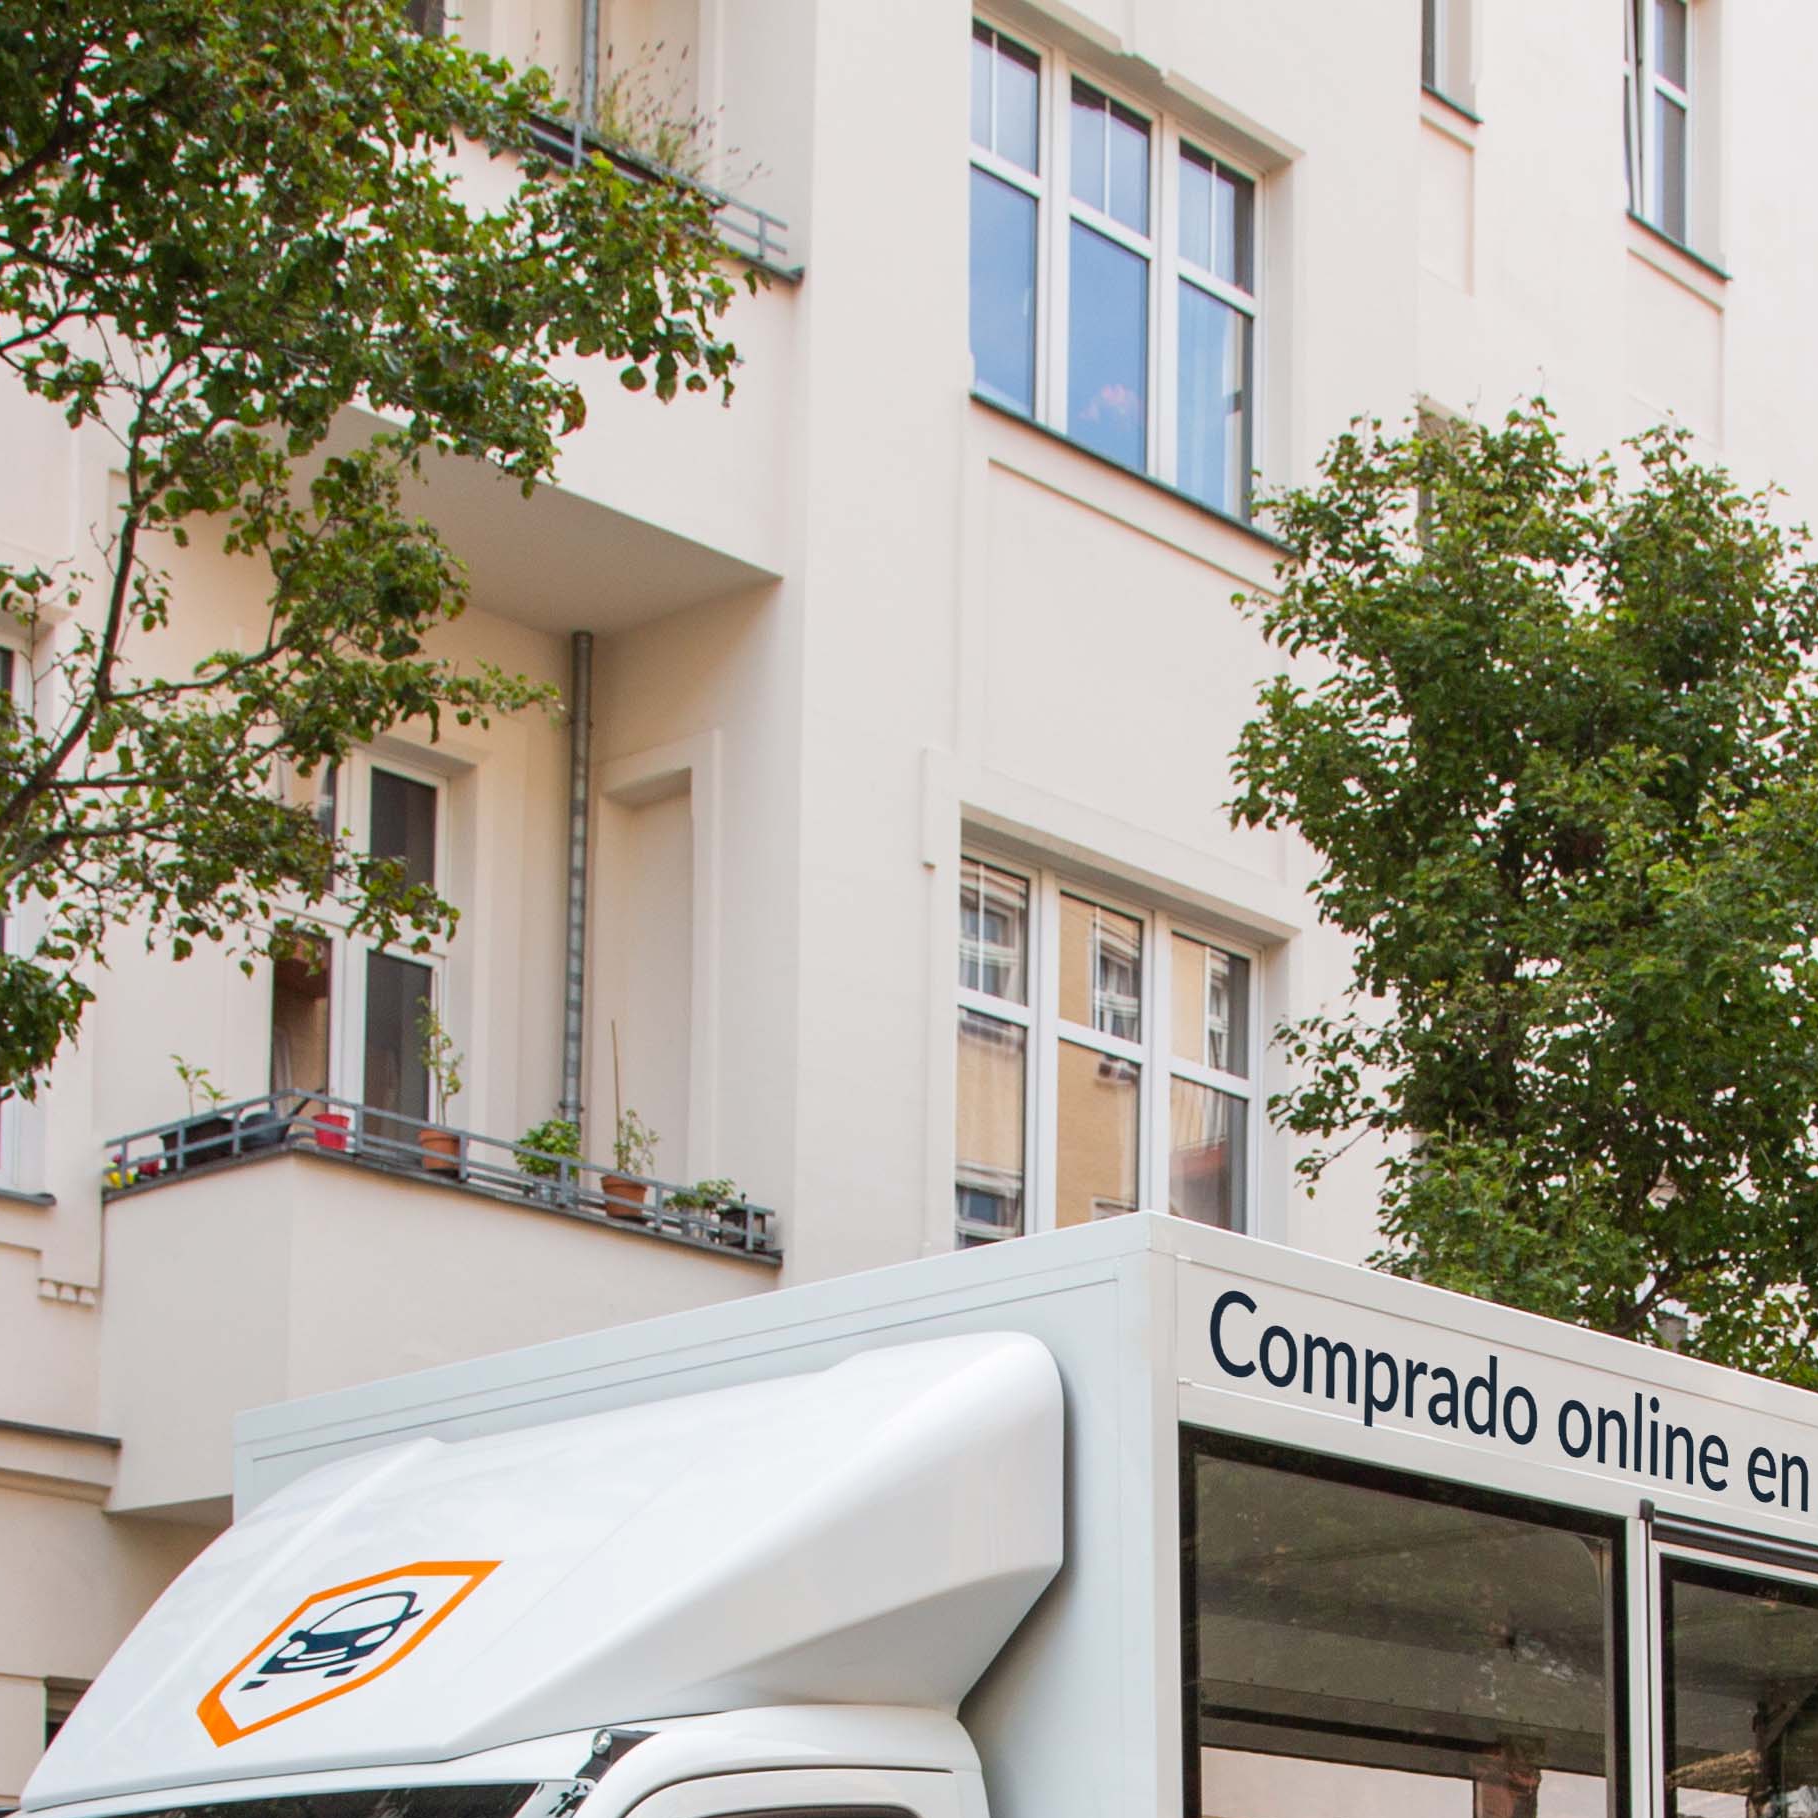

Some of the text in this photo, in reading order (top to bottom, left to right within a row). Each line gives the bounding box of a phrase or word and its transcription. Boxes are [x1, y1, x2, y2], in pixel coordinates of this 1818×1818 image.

[1208, 1290, 1538, 1446] Comprado
[1558, 1391, 1729, 1492] online
[1747, 1446, 1809, 1513] en
